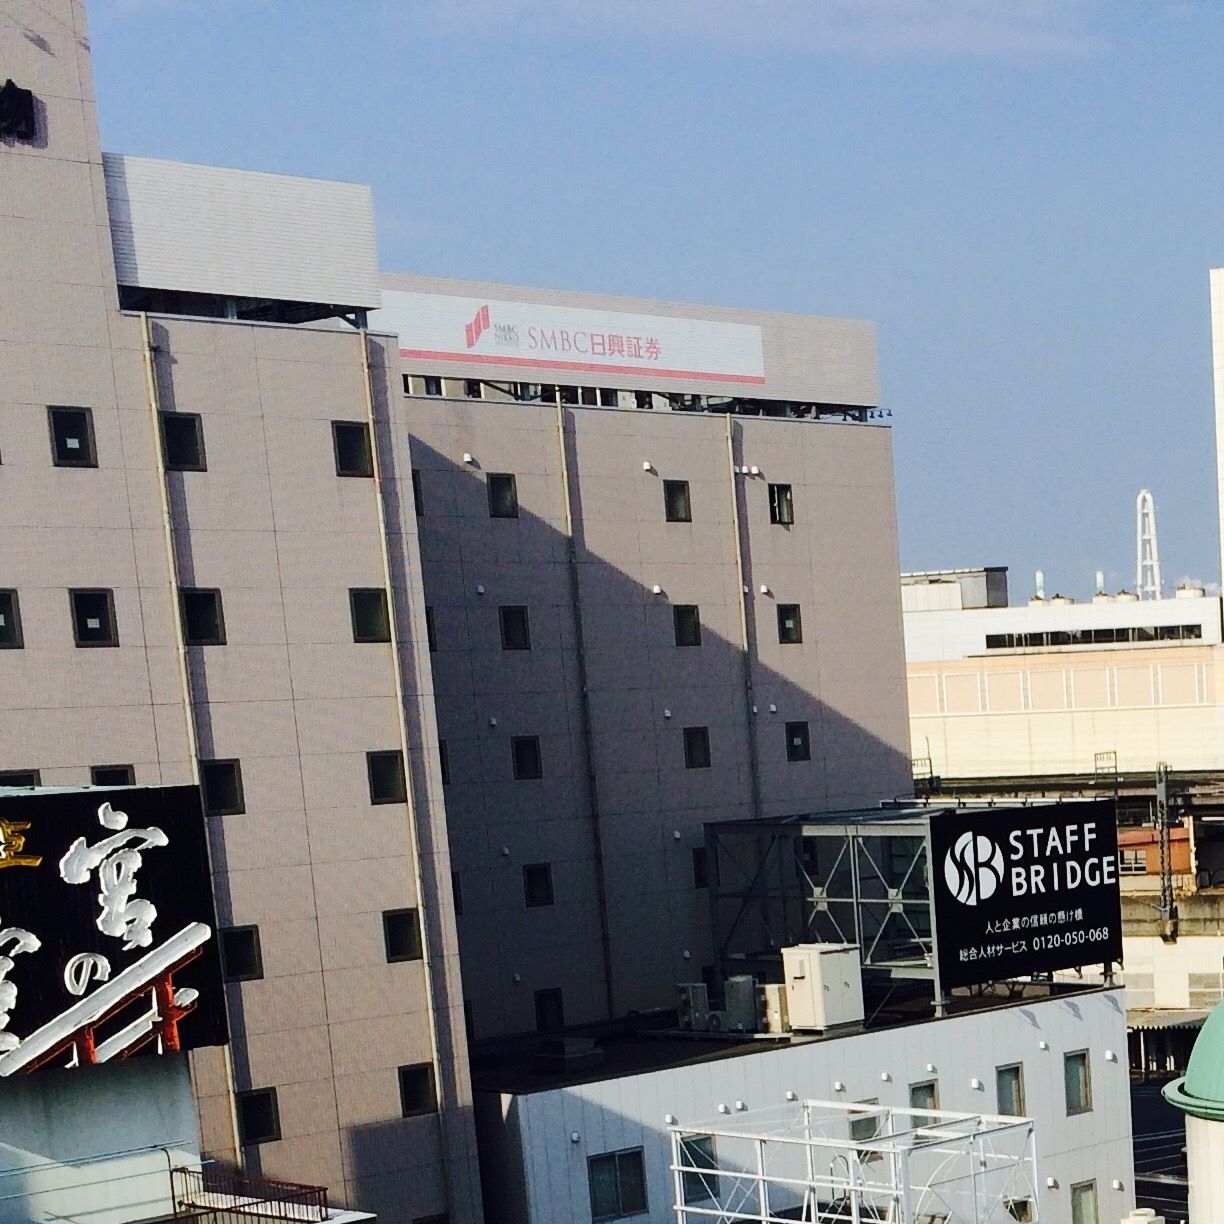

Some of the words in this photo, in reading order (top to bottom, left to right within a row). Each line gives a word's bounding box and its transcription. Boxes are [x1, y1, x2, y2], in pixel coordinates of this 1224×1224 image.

[528, 326, 661, 361] SMBC日興証券
[1008, 822, 1097, 861] STAFF
[1011, 856, 1117, 897] BRIDGE
[1032, 926, 1109, 951] 0120-050-068
